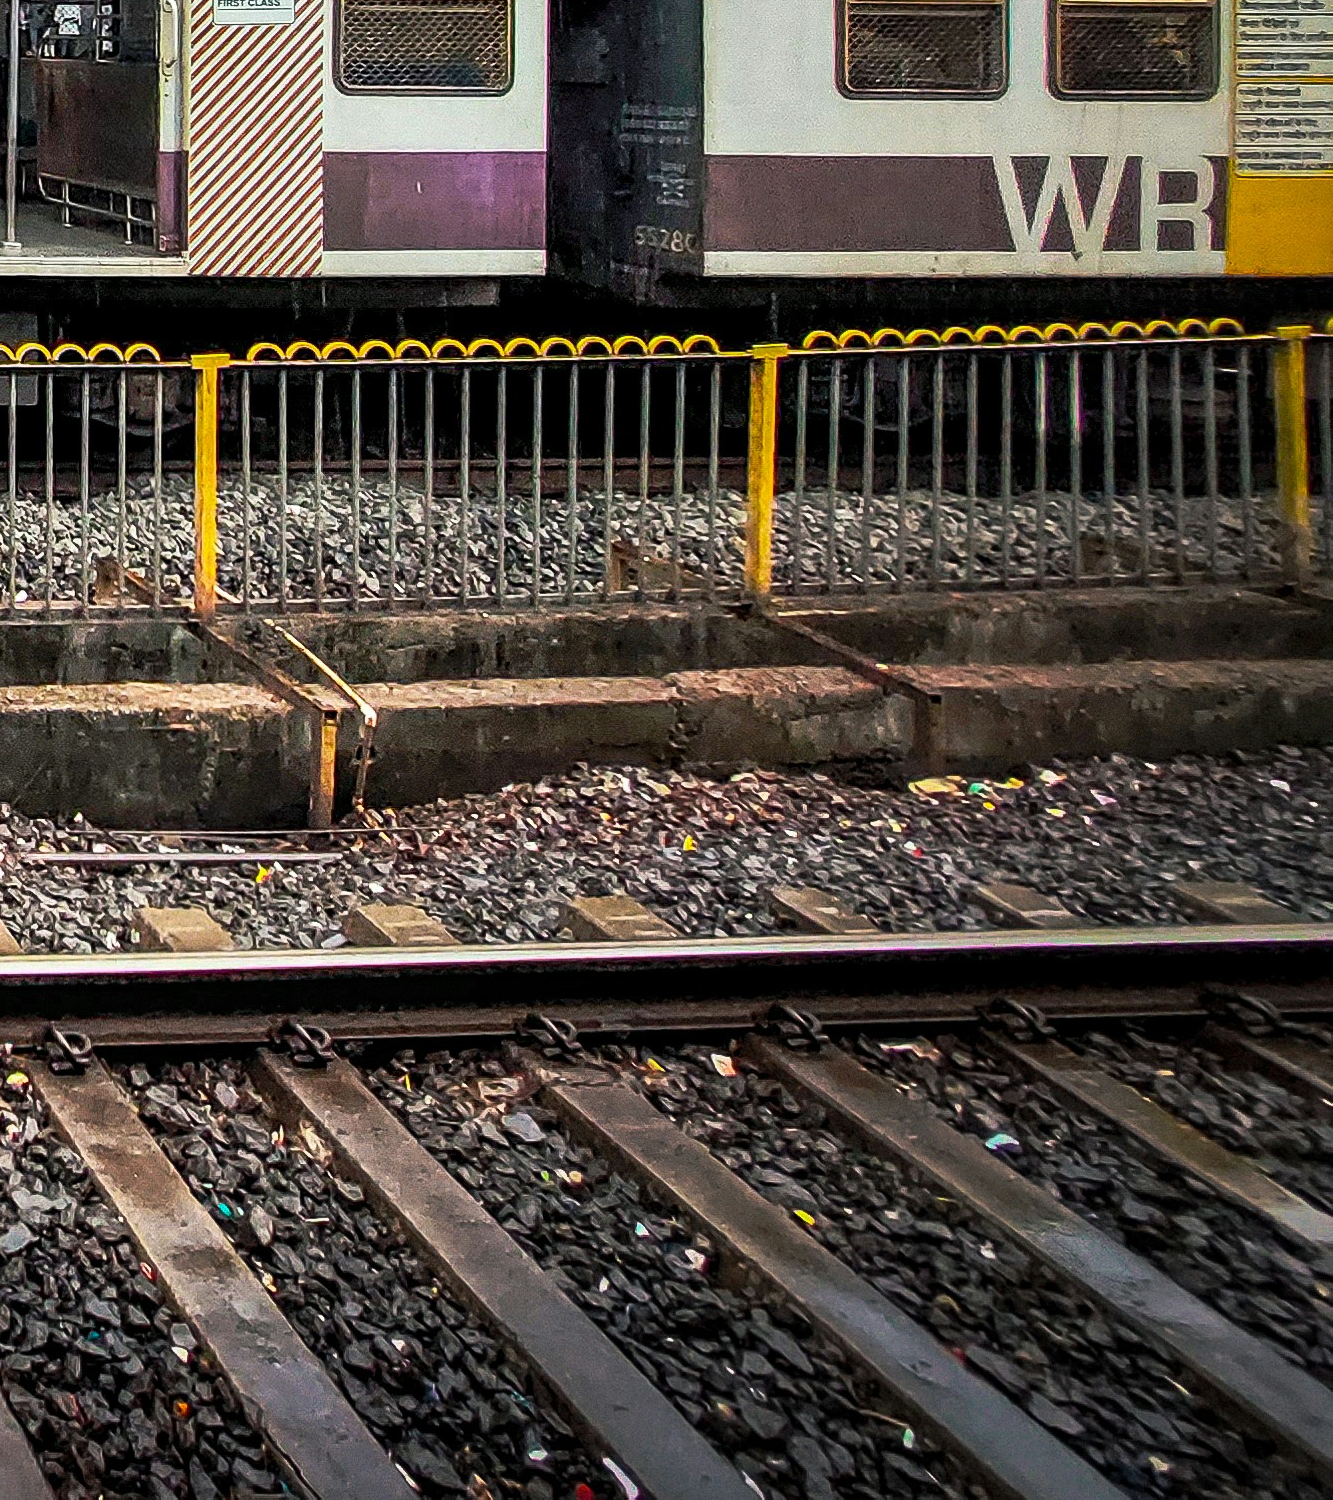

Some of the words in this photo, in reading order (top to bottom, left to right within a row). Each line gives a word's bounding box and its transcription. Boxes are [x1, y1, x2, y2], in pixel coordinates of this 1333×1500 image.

[217, 0, 245, 7] FIRST
[247, 0, 281, 7] CLASS
[993, 155, 1217, 252] WR
